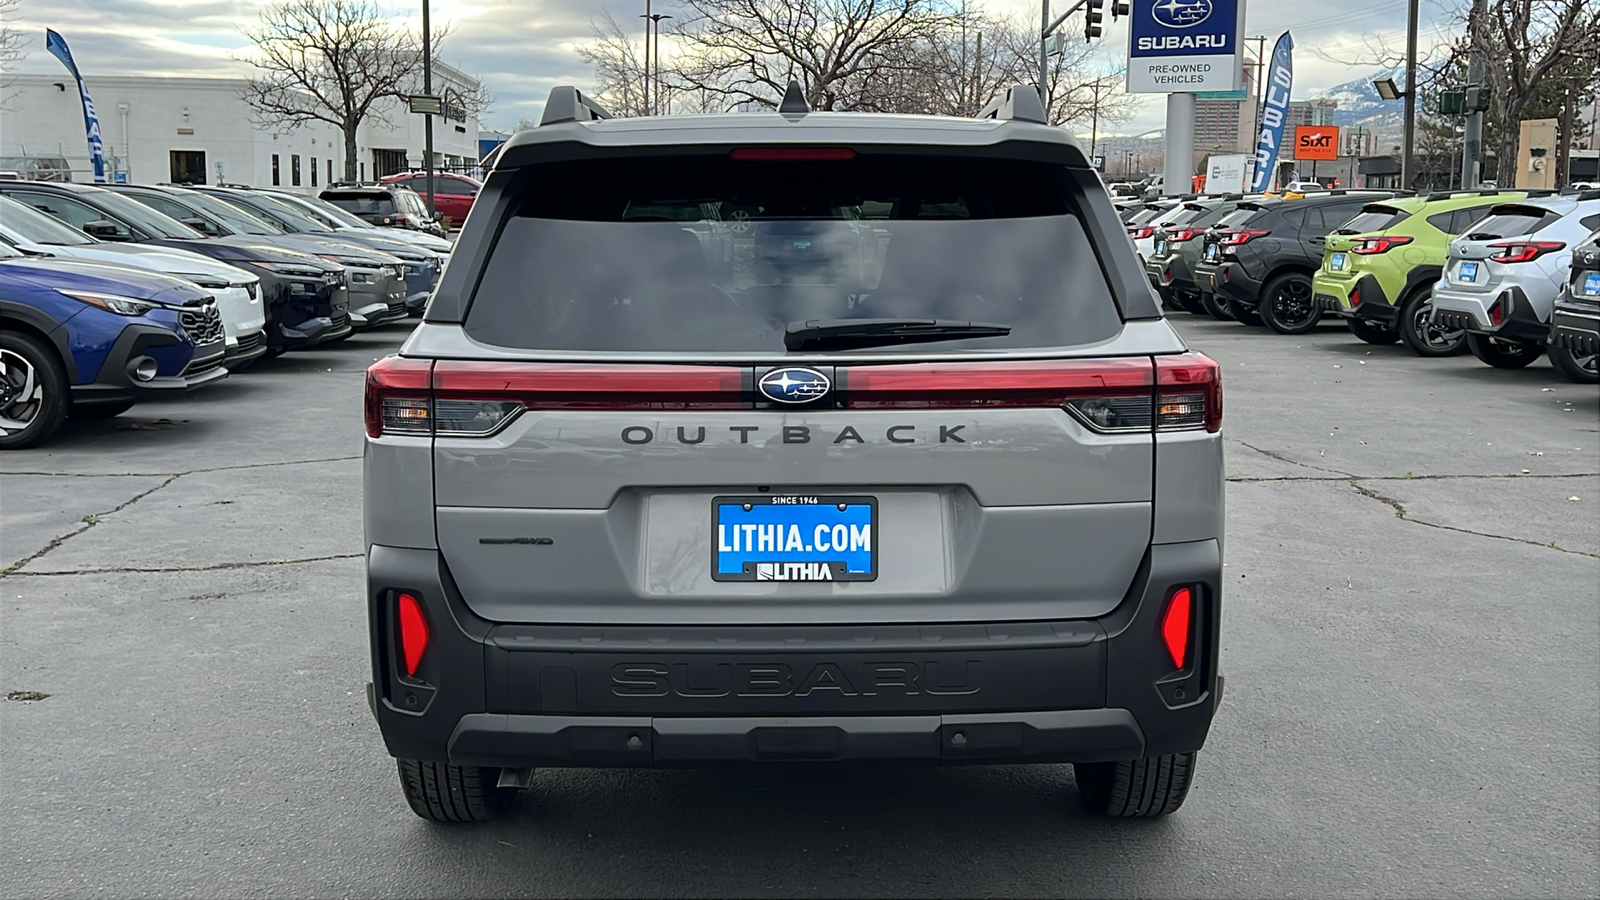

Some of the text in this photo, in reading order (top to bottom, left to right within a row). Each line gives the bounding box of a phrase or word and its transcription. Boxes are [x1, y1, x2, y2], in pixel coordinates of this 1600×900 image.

[1138, 34, 1226, 50] SUBARU
[1148, 64, 1211, 74] PRE-OWNED
[1154, 75, 1204, 84] VEHICLES
[1253, 66, 1291, 188] SUBARU
[621, 425, 967, 444] OUTBACK
[772, 496, 819, 505] SINCE 1946
[718, 524, 871, 552] LITHIA.COM
[773, 562, 833, 581] LITHIA
[611, 661, 983, 698] SUBARU
